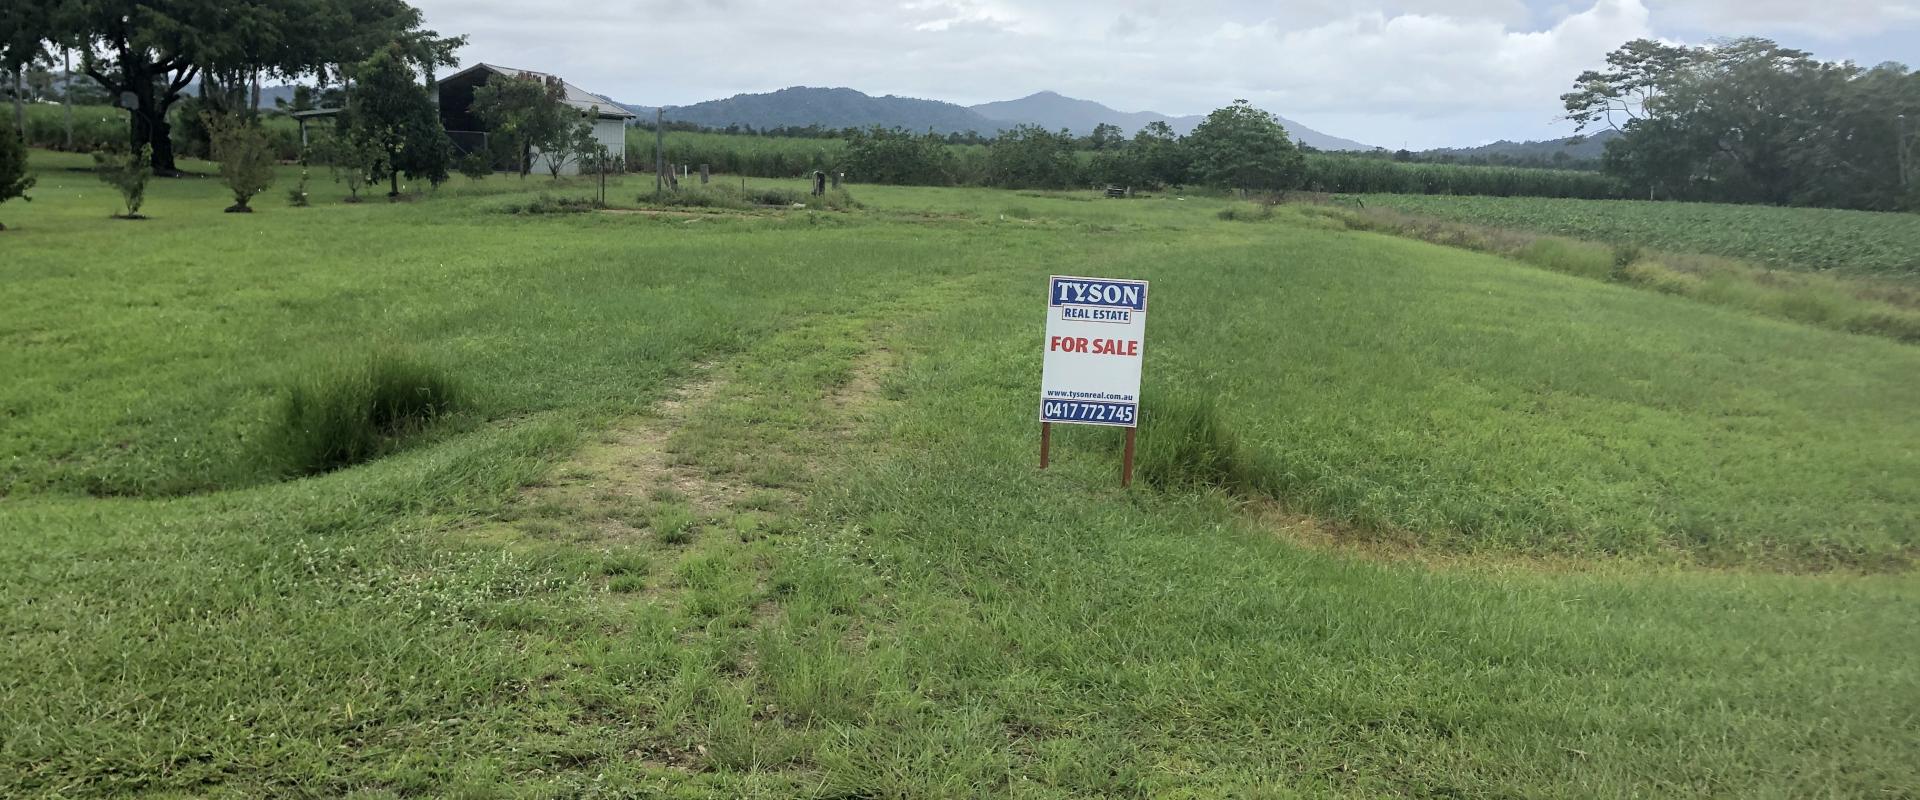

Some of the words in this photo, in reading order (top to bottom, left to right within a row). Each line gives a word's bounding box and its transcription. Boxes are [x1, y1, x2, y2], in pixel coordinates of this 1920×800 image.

[1058, 282, 1139, 305] TYSON
[1065, 308, 1090, 318] REAL
[1094, 310, 1129, 320] ESTATE
[1050, 336, 1088, 353] FOR
[1092, 338, 1138, 356] SALE
[1047, 390, 1133, 400] www.tysonreal.com.au
[1045, 402, 1078, 418] 0417
[1081, 404, 1106, 420] 772
[1108, 405, 1133, 422] 745
